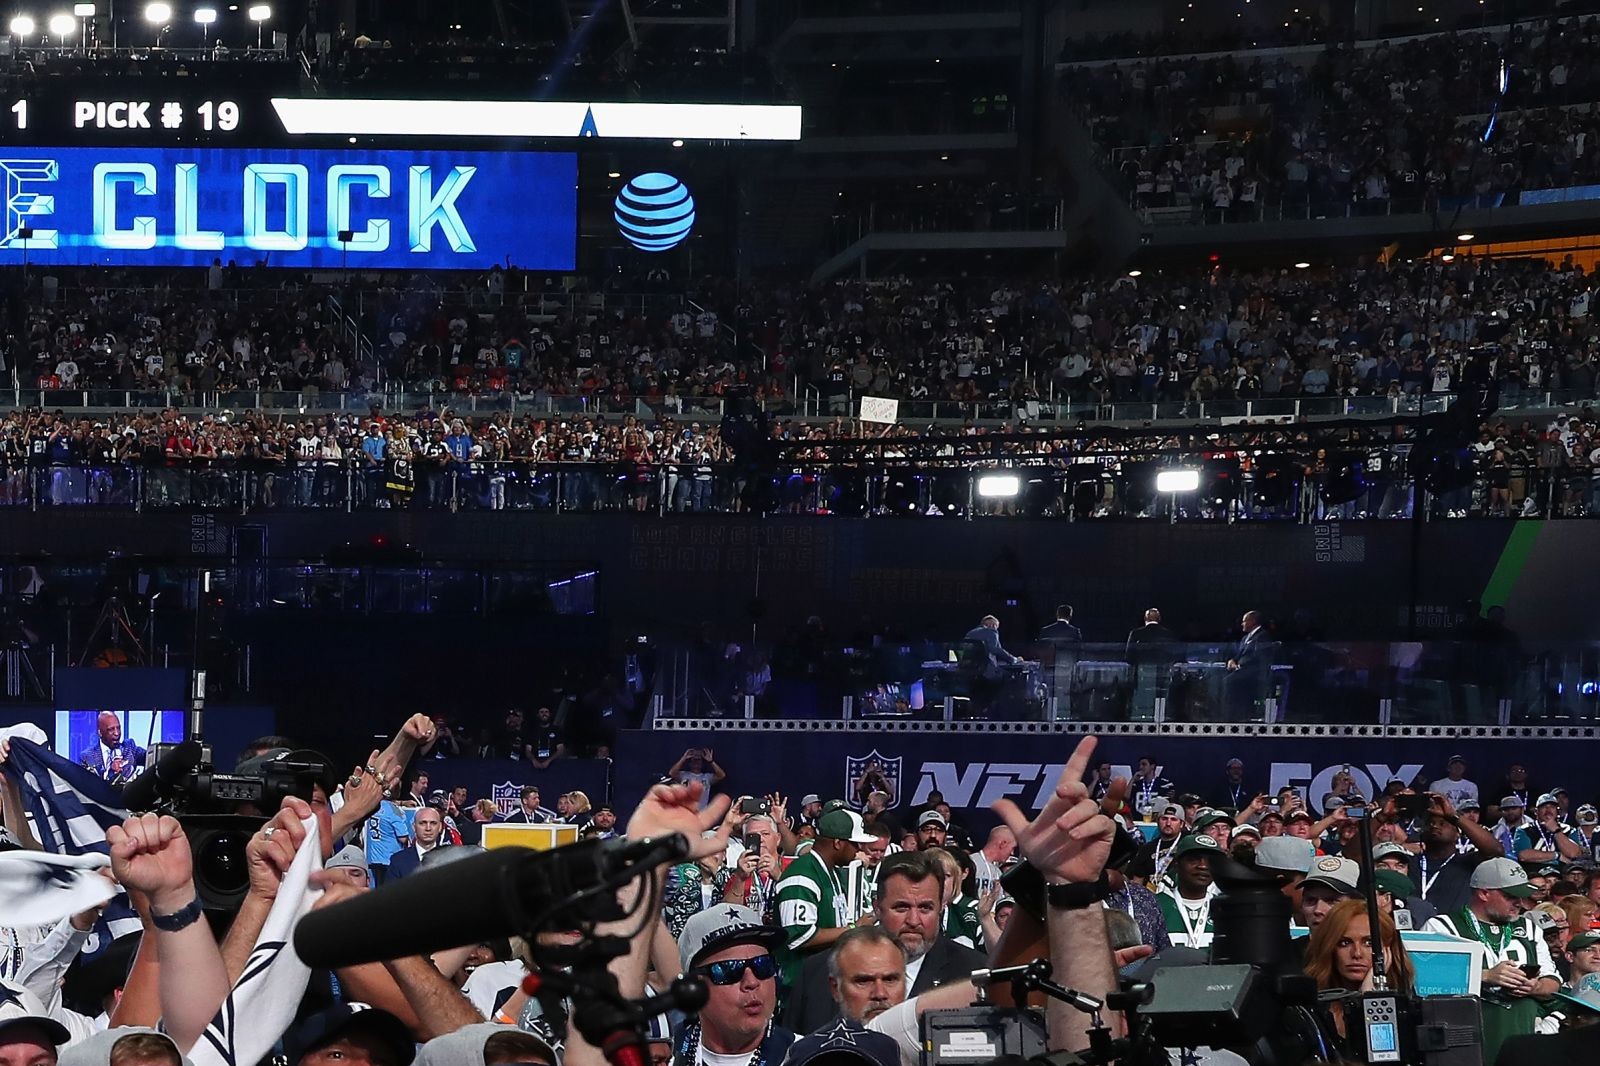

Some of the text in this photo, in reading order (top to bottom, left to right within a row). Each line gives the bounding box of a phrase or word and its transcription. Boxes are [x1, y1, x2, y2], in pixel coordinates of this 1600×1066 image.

[11, 100, 29, 130] 1
[74, 100, 240, 131] PICK # 19
[92, 162, 478, 254] CLOCK
[34, 439, 47, 454] 21
[302, 444, 315, 456] 18
[1268, 762, 1427, 811] FOX
[793, 903, 806, 921] 12
